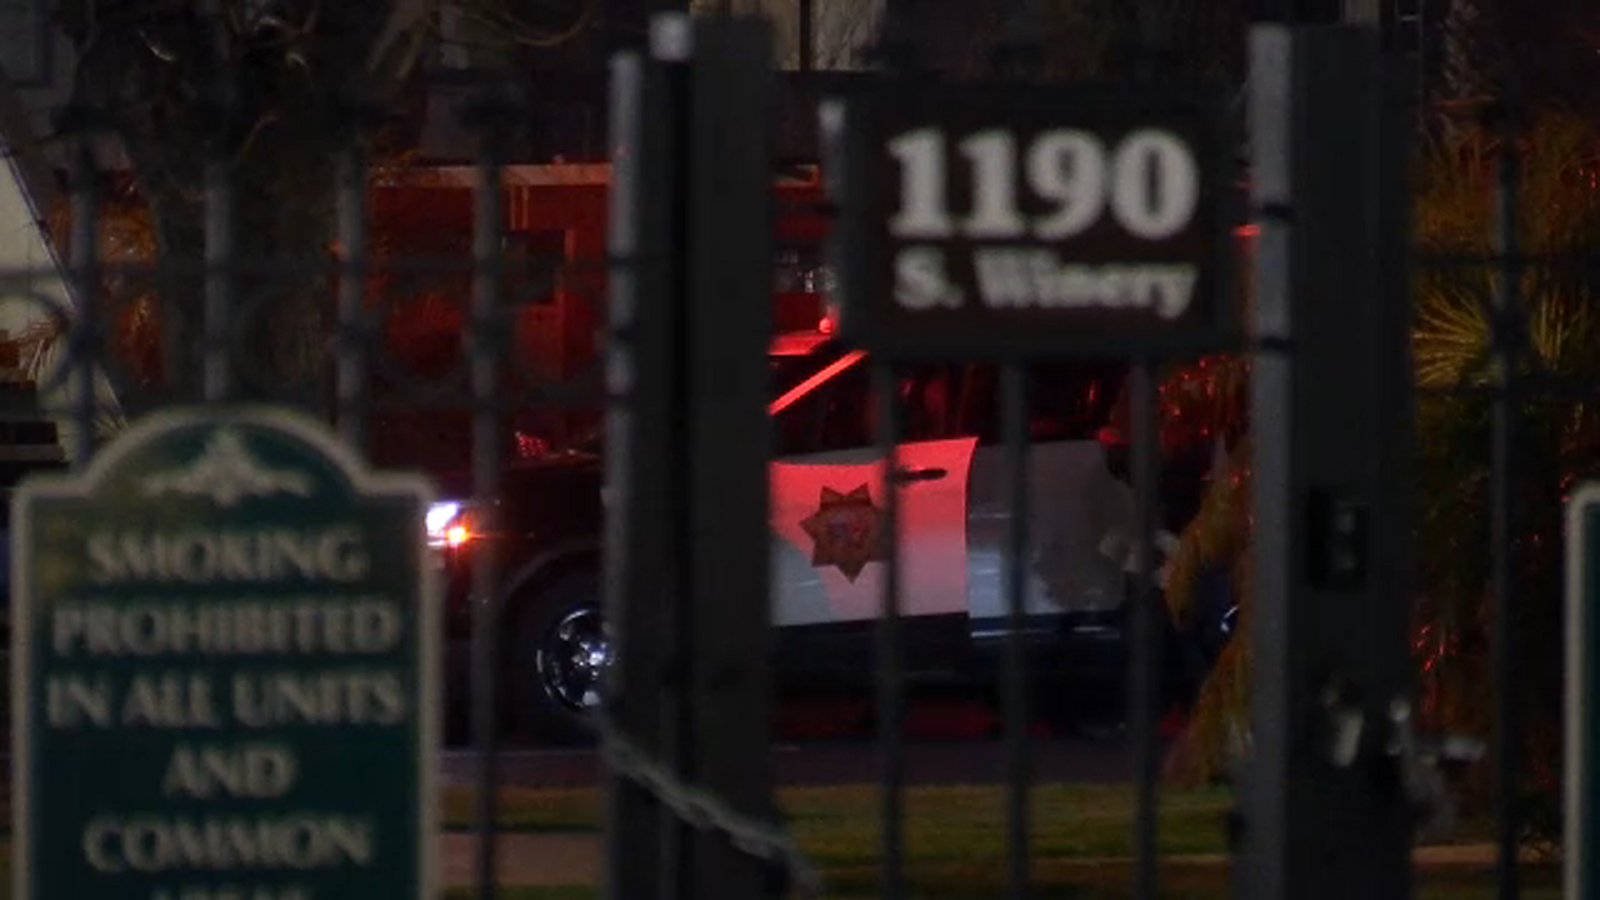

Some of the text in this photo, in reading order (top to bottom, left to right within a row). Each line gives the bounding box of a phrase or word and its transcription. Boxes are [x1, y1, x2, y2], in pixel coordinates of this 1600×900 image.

[886, 128, 1199, 240] 1190
[893, 250, 1198, 320] S. Winery
[87, 526, 368, 582] SMOKING
[52, 600, 397, 656] PROHIBITED
[47, 670, 404, 729] IN ALL UNITS
[162, 742, 298, 799] AND
[82, 814, 372, 872] COMMON
